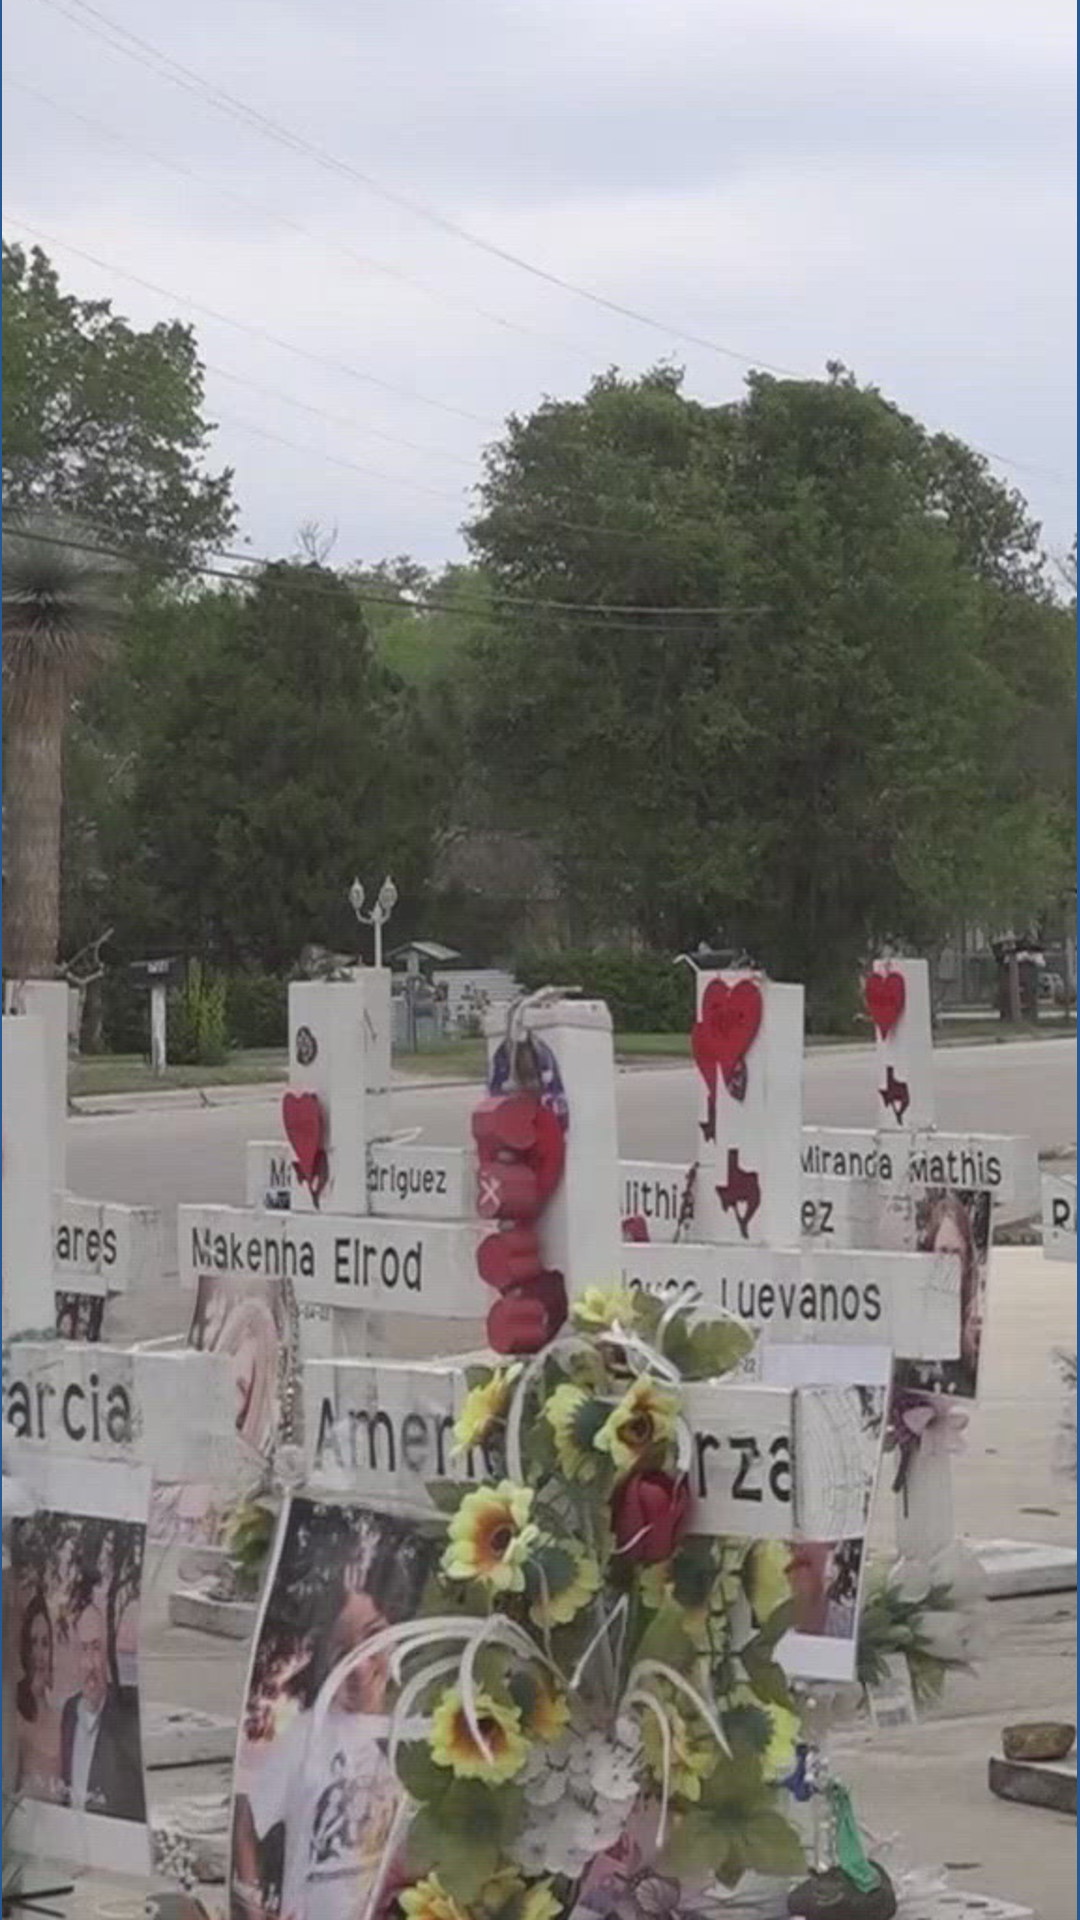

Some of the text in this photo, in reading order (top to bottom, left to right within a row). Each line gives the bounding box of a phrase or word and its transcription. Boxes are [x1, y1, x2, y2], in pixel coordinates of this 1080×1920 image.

[801, 1146, 1002, 1186] Miranda Mathis
[801, 1200, 834, 1234] ez
[56, 1225, 117, 1264] ares
[192, 1227, 423, 1292] Makenna Elrod
[7, 1373, 133, 1443] arcia
[695, 1432, 791, 1502] rza
